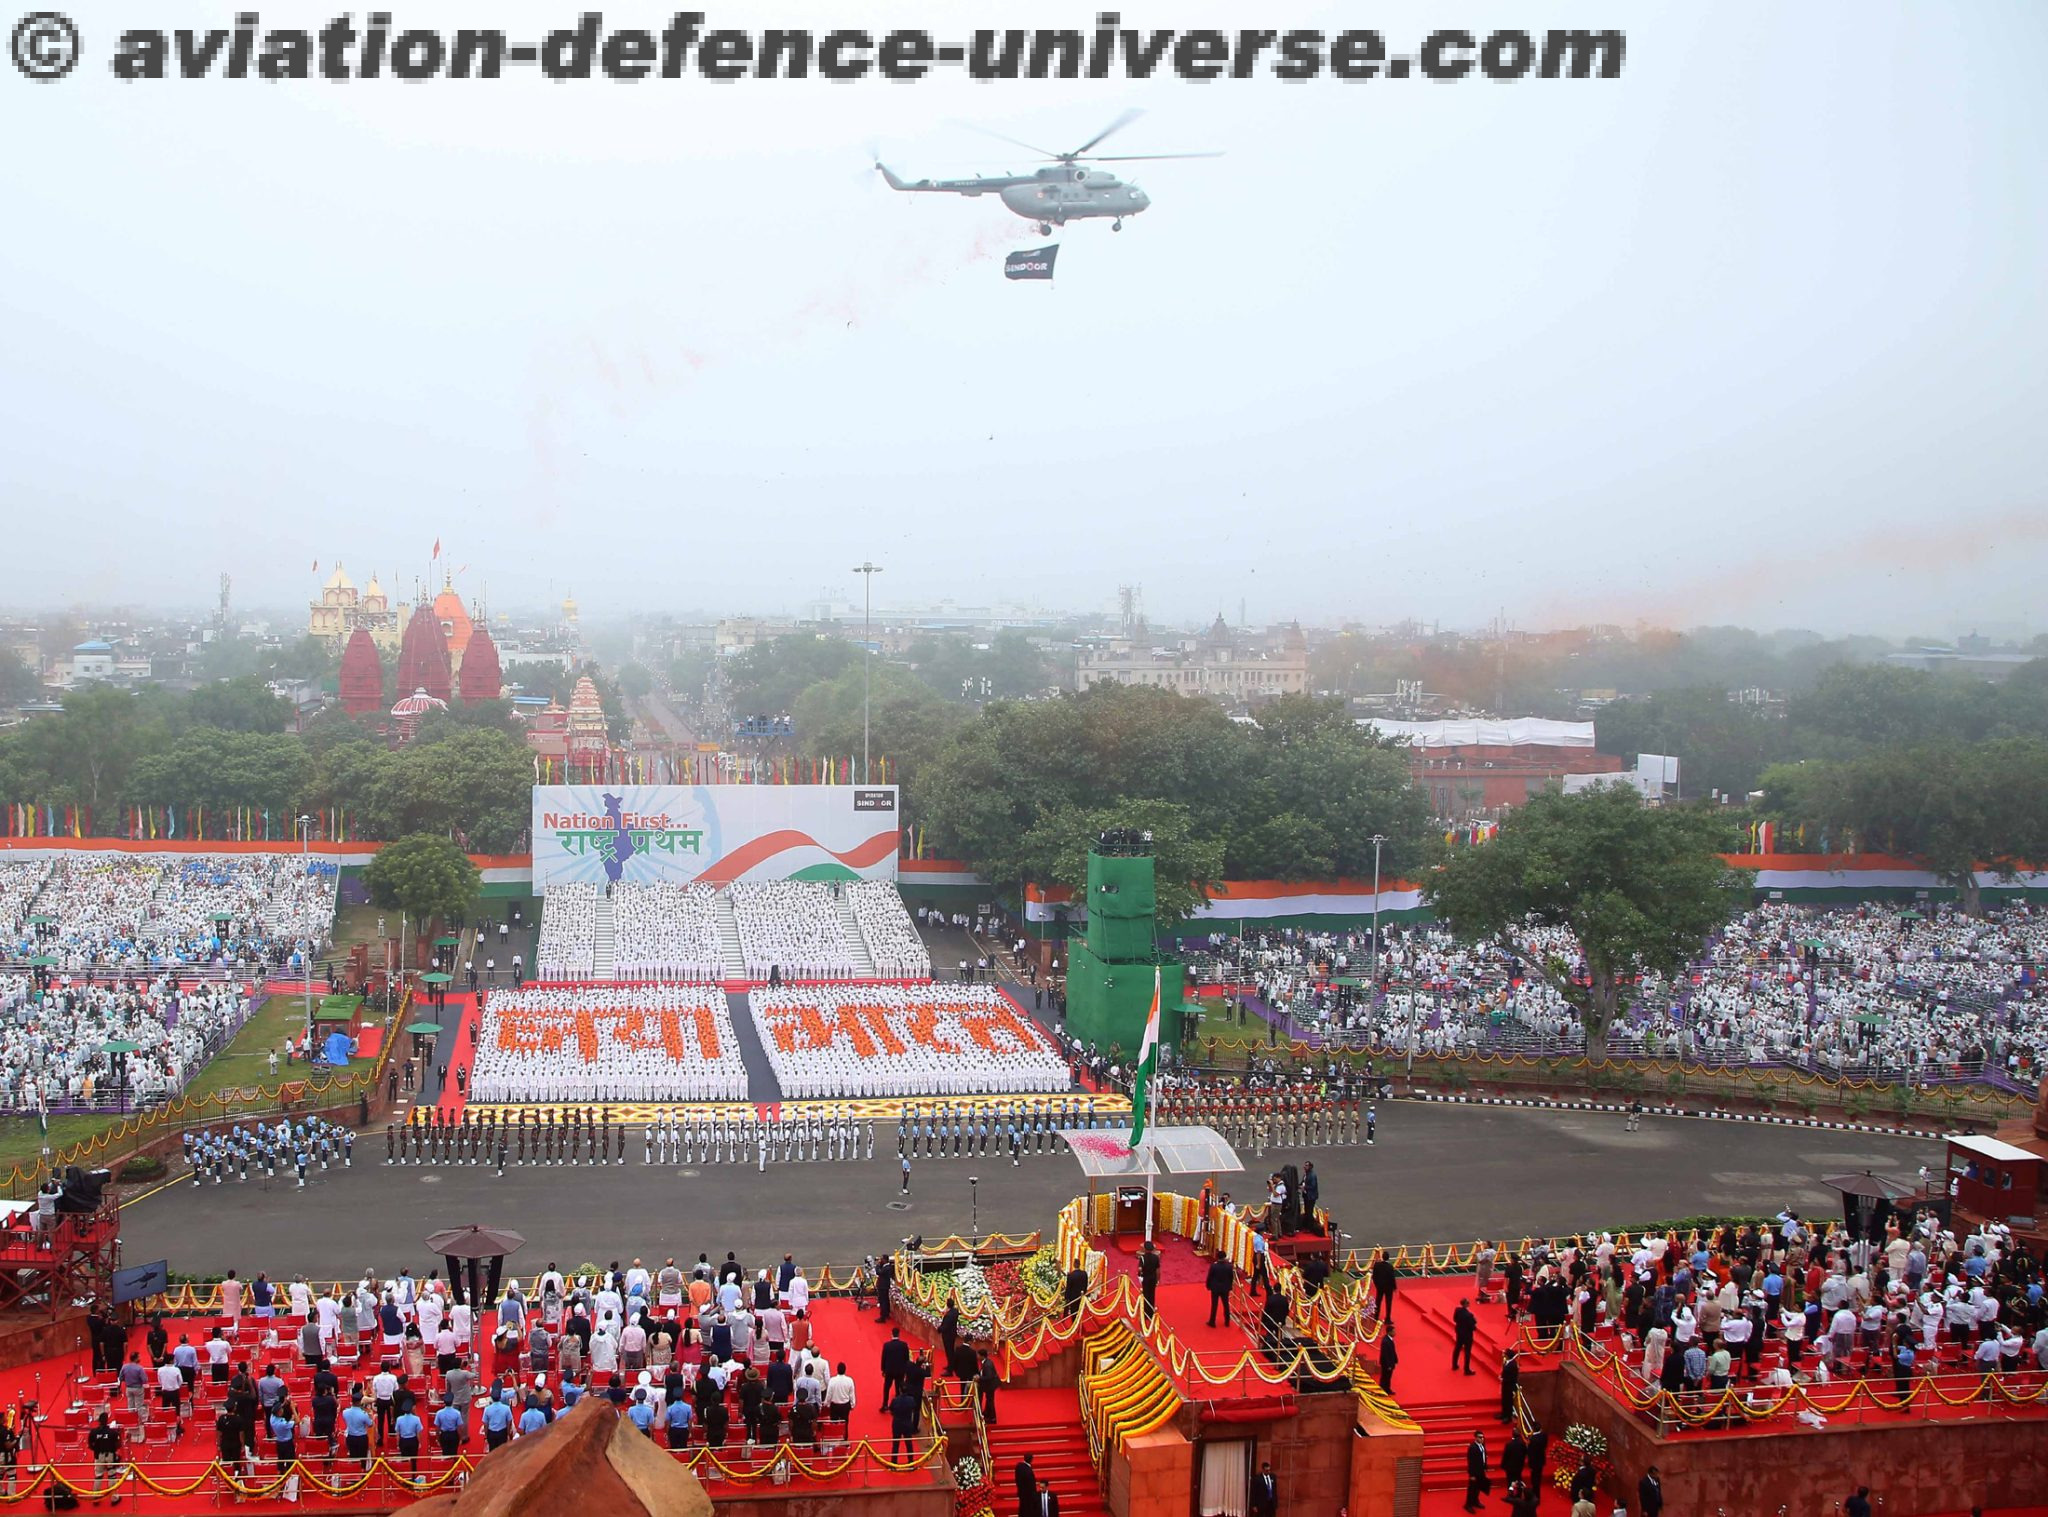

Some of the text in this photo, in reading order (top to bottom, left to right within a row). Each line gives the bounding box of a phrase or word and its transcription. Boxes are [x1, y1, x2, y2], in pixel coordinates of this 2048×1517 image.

[1006, 262, 1048, 272] SINDOOR
[543, 812, 615, 829] Nation
[556, 830, 703, 862] राष्ट्र प्रथम
